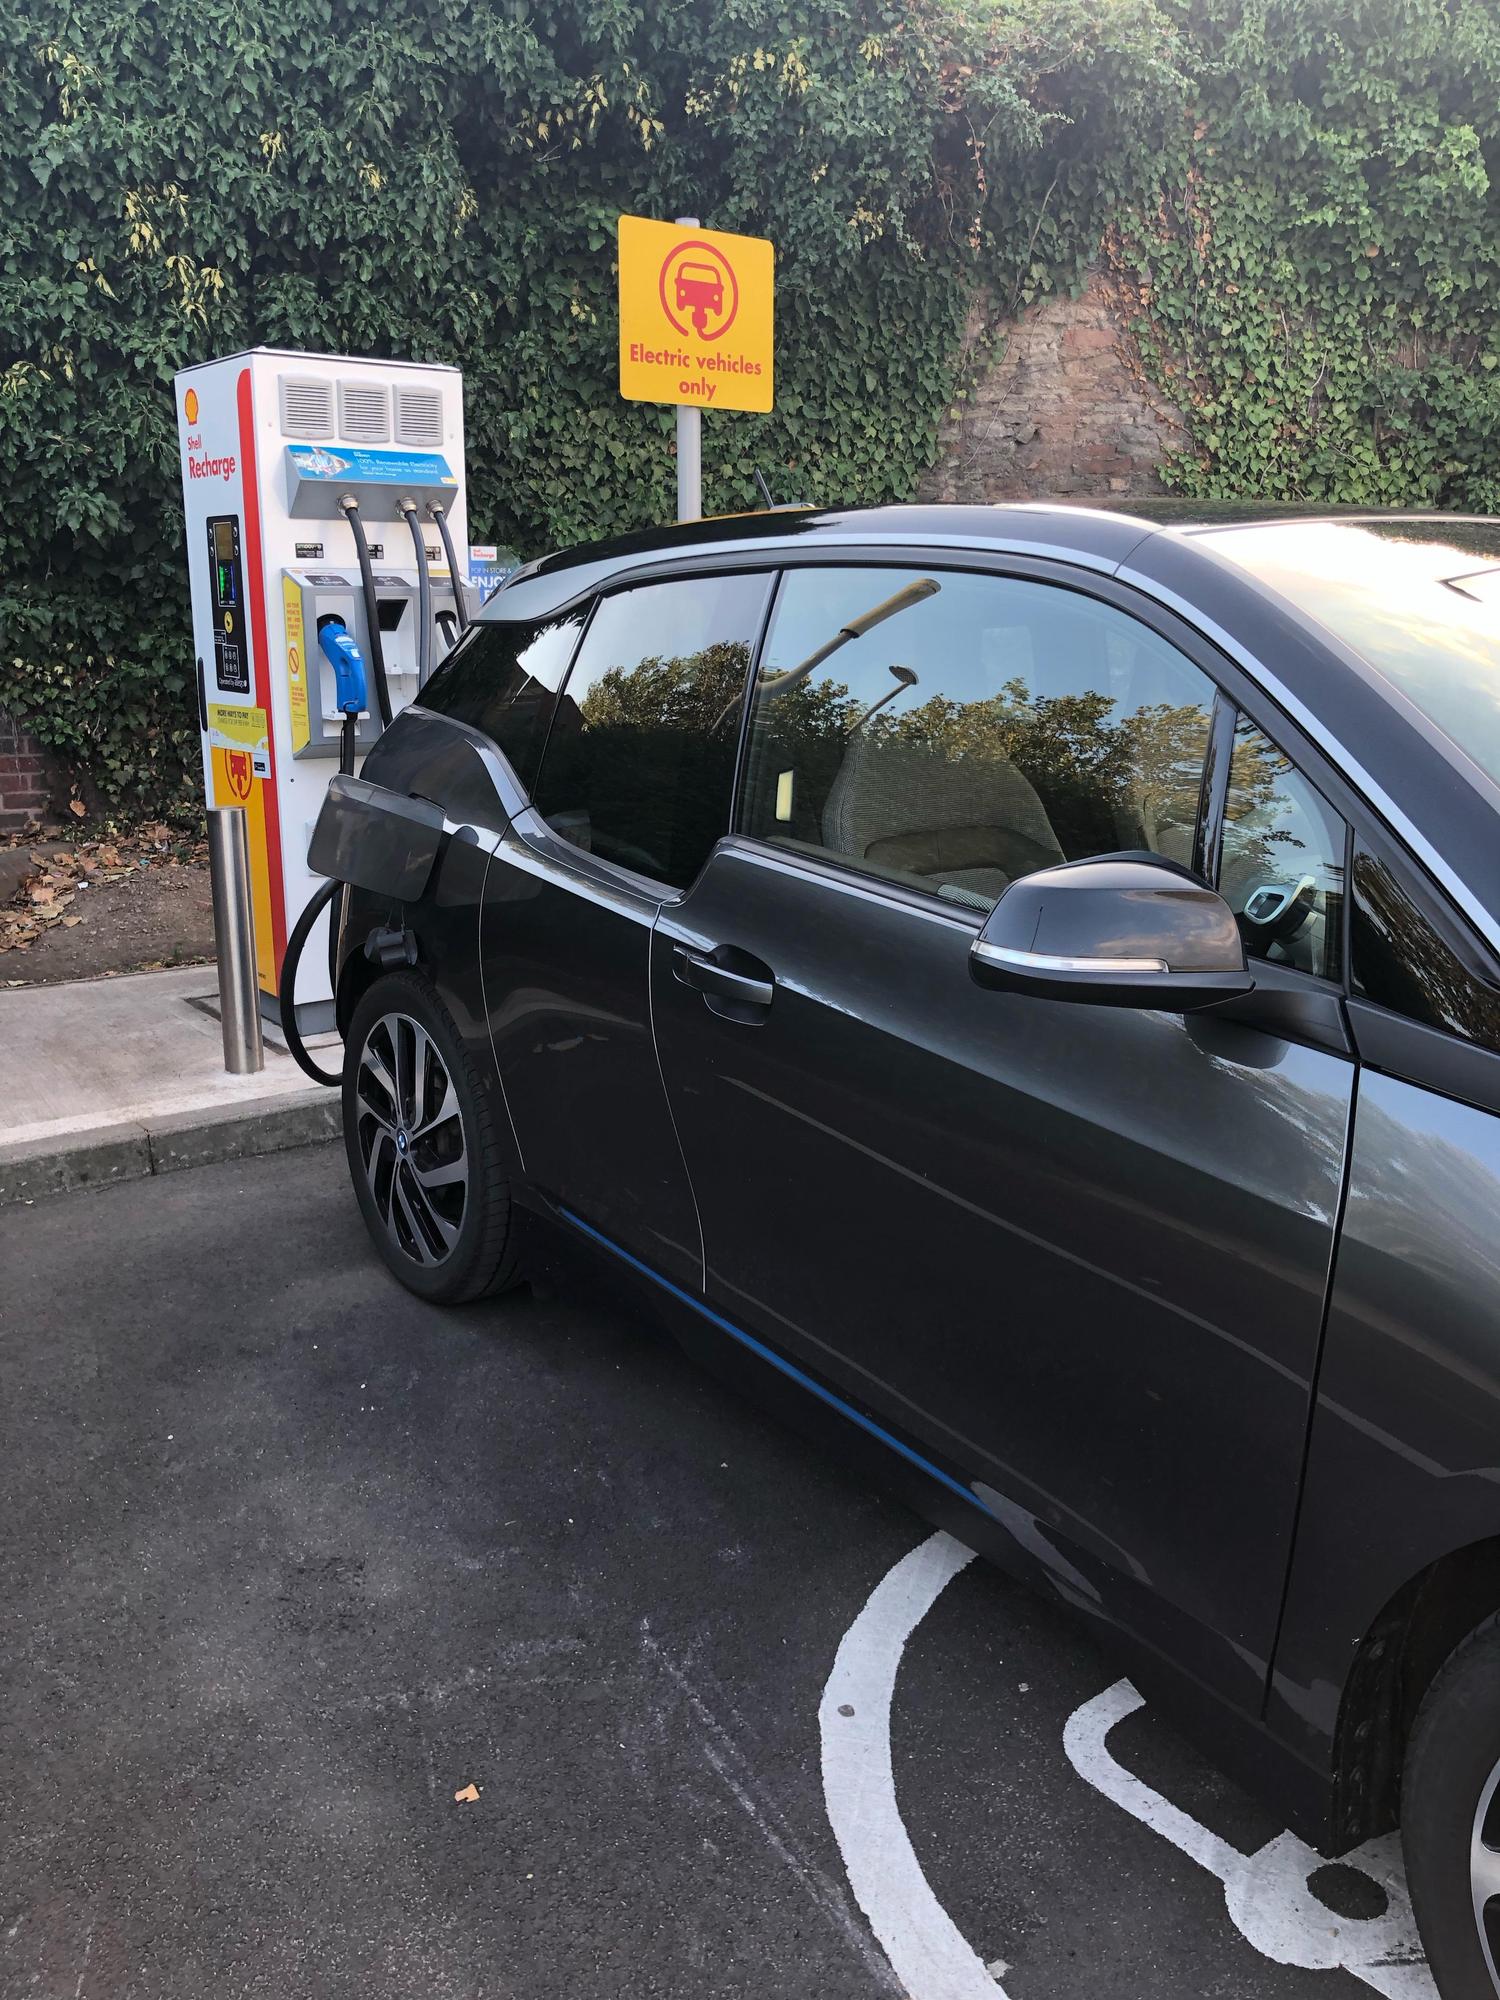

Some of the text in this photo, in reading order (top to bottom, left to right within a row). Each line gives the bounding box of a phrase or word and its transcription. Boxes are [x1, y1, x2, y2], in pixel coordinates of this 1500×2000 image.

[630, 344, 762, 375] Electric vehicles
[679, 377, 717, 401] only
[187, 434, 202, 451] Shell
[188, 452, 236, 482] Recharge
[471, 576, 506, 588] ENJO
